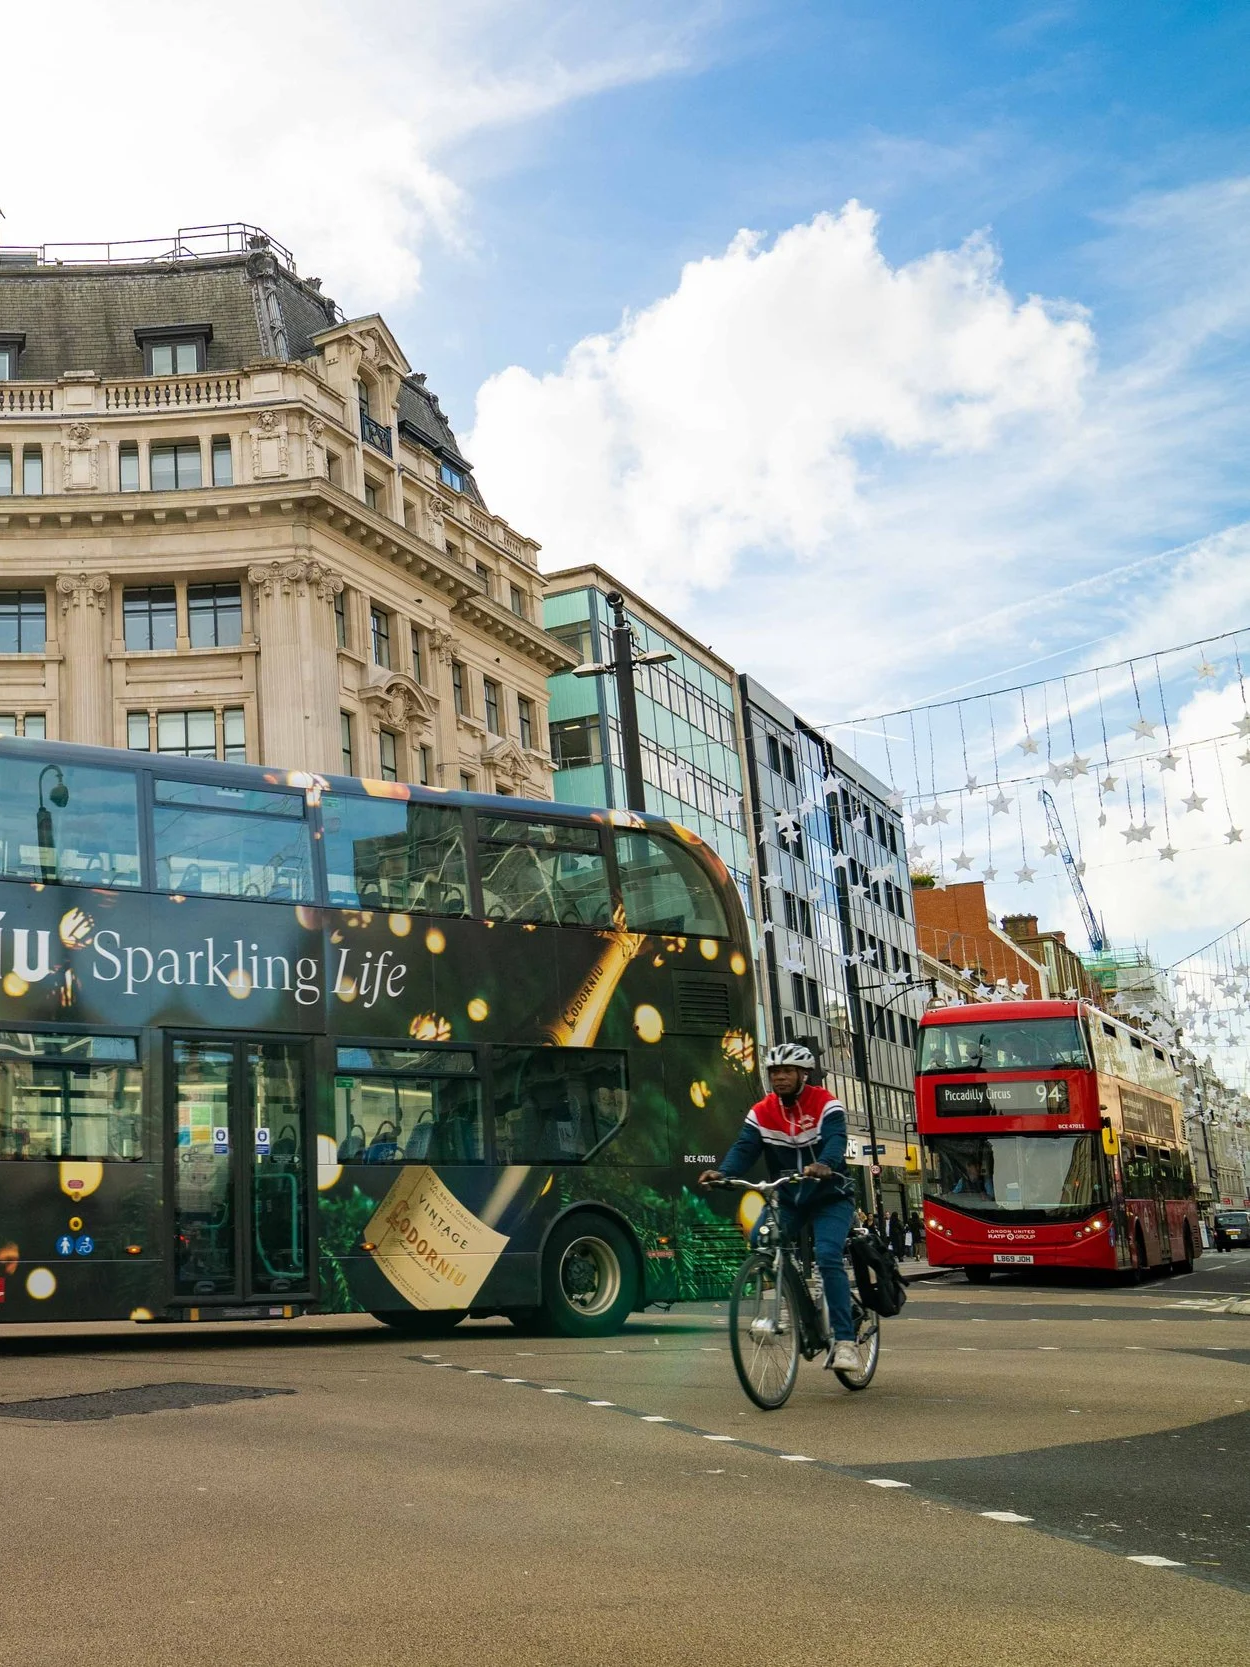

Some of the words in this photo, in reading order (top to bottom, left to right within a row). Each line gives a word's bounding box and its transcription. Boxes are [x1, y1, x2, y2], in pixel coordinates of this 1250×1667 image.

[93, 930, 320, 1005] Sparkling
[331, 948, 407, 1008] Life
[945, 1089, 983, 1103] Piccadilly
[986, 1087, 1011, 1100] Circus
[1035, 1085, 1062, 1103] 94
[684, 1155, 697, 1163] BCE
[697, 1155, 716, 1163] 47016
[418, 1193, 469, 1250] VINTAGE
